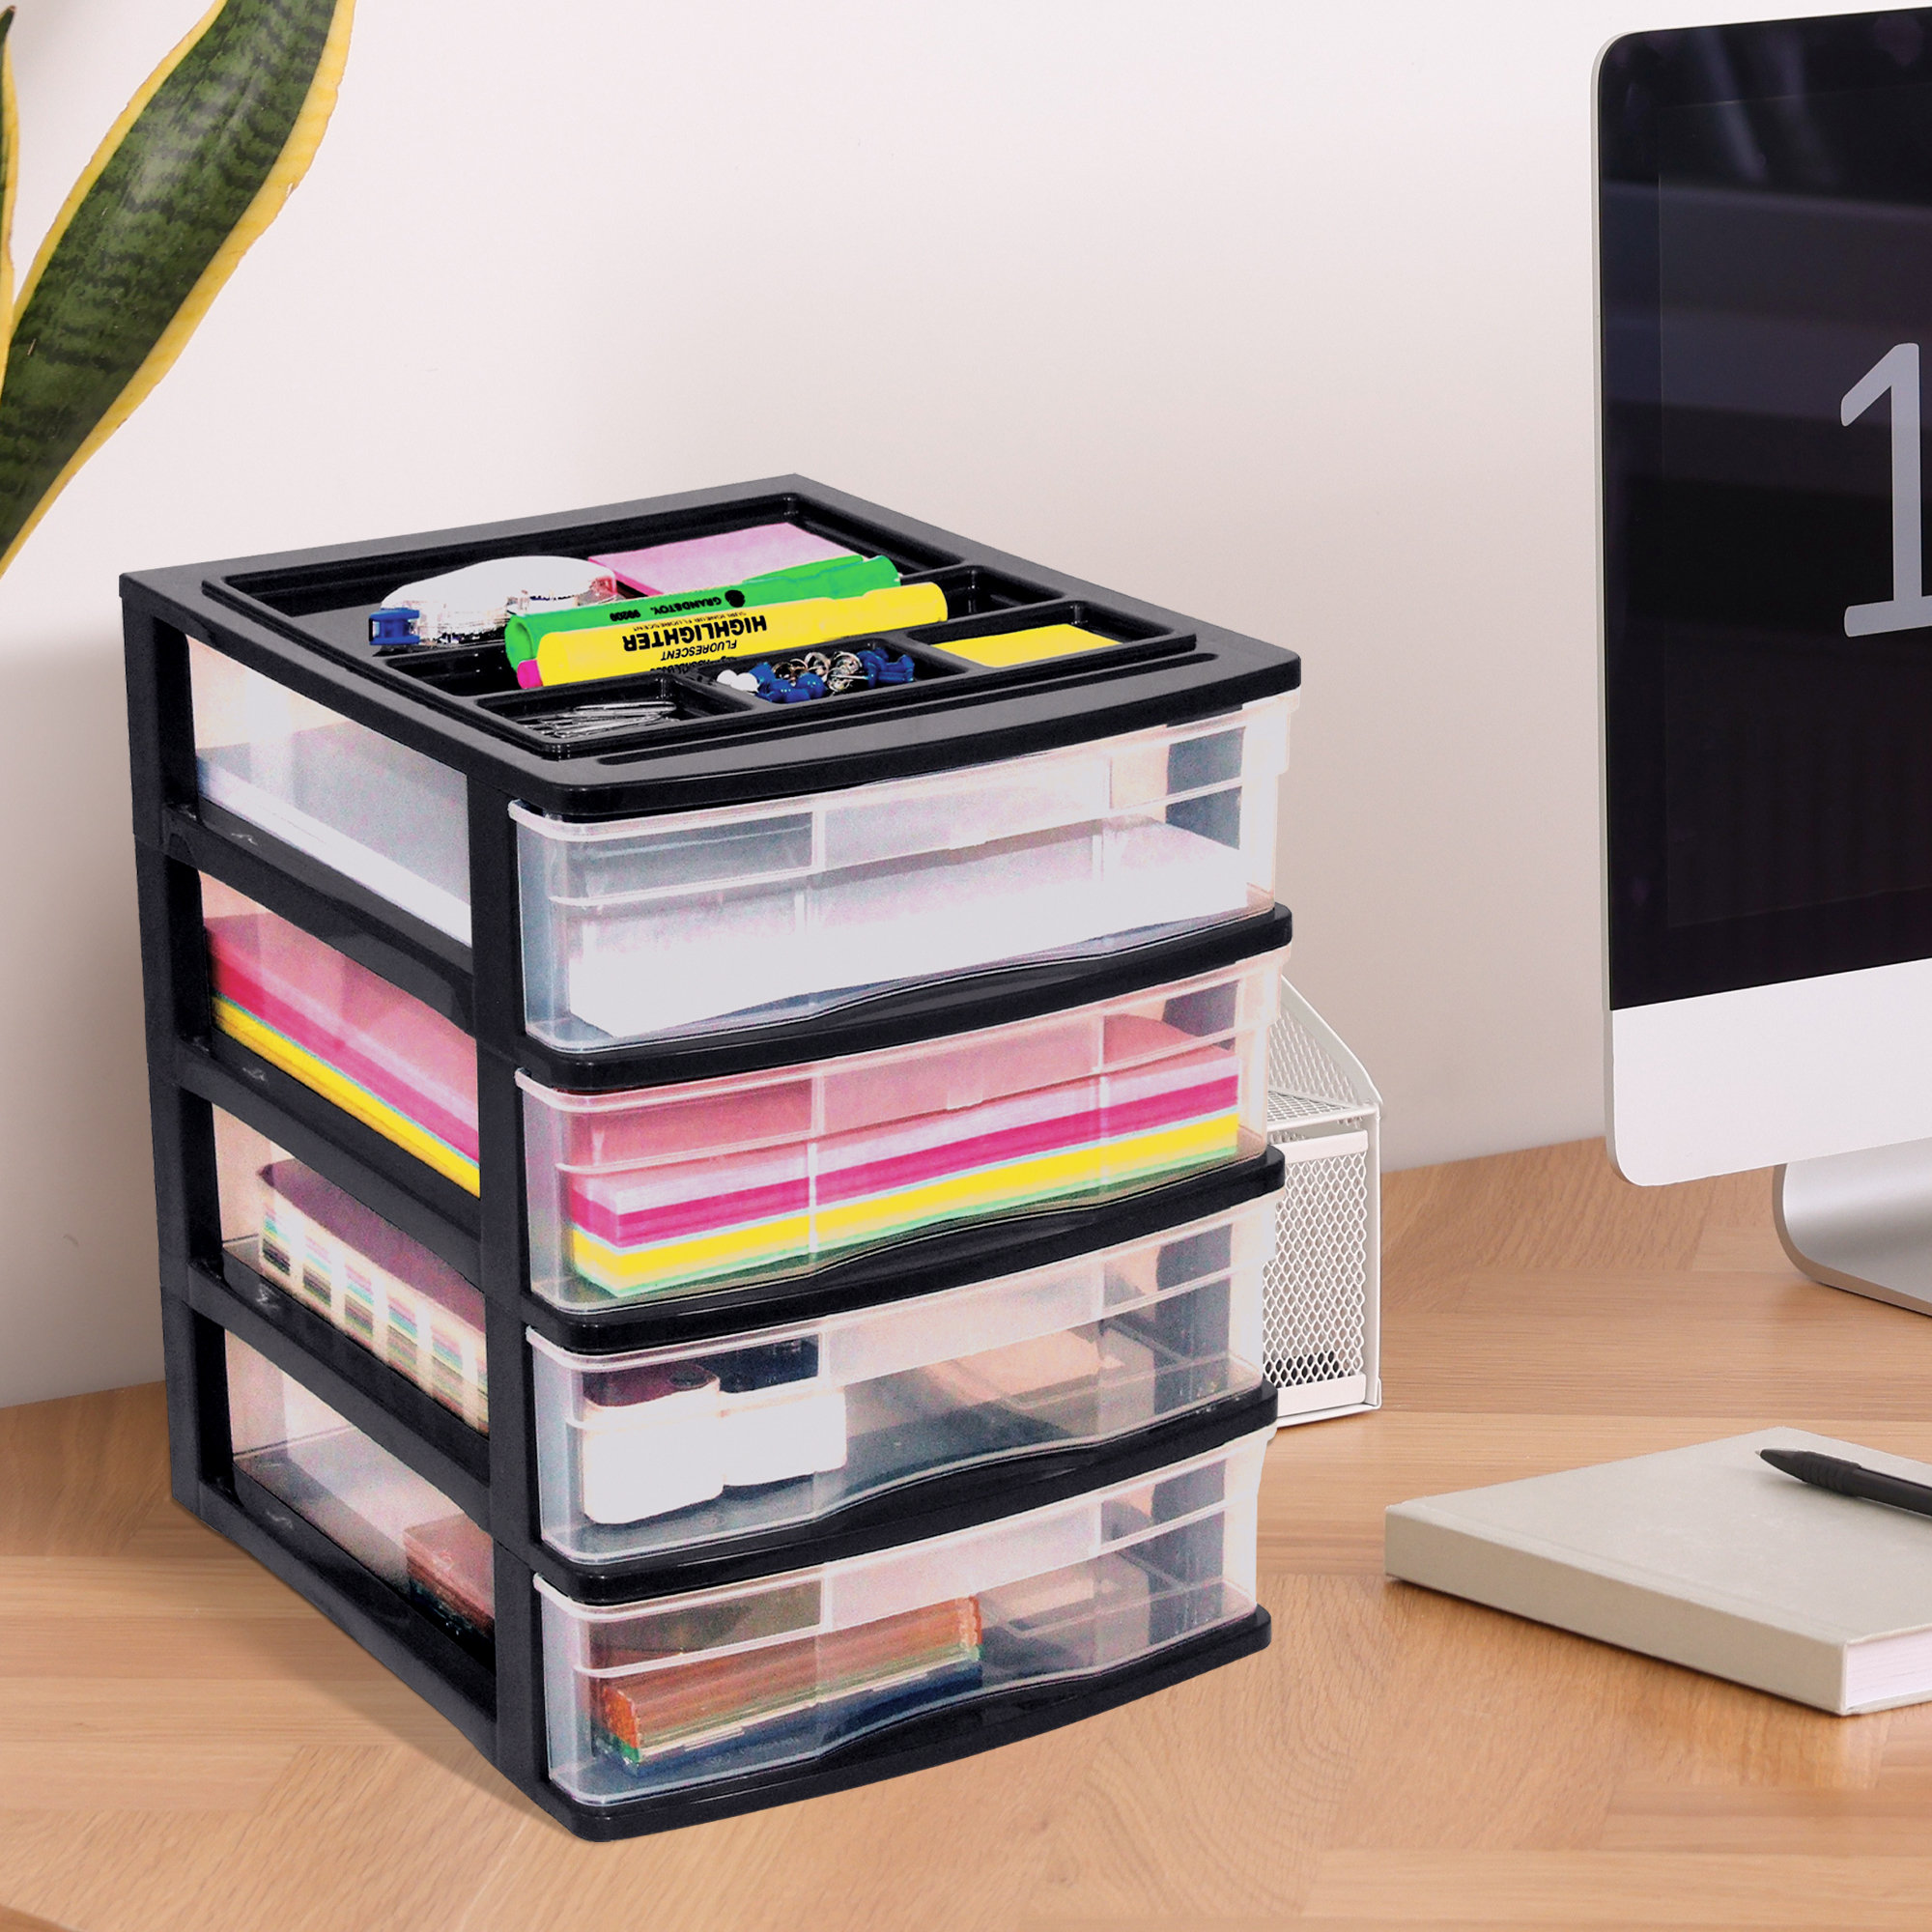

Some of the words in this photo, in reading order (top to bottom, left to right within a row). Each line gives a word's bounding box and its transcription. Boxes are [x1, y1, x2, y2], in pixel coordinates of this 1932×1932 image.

[1840, 342, 1932, 638] 1
[622, 615, 768, 652] HIGHLIGHTER
[660, 639, 737, 662] FLUORESCENT
